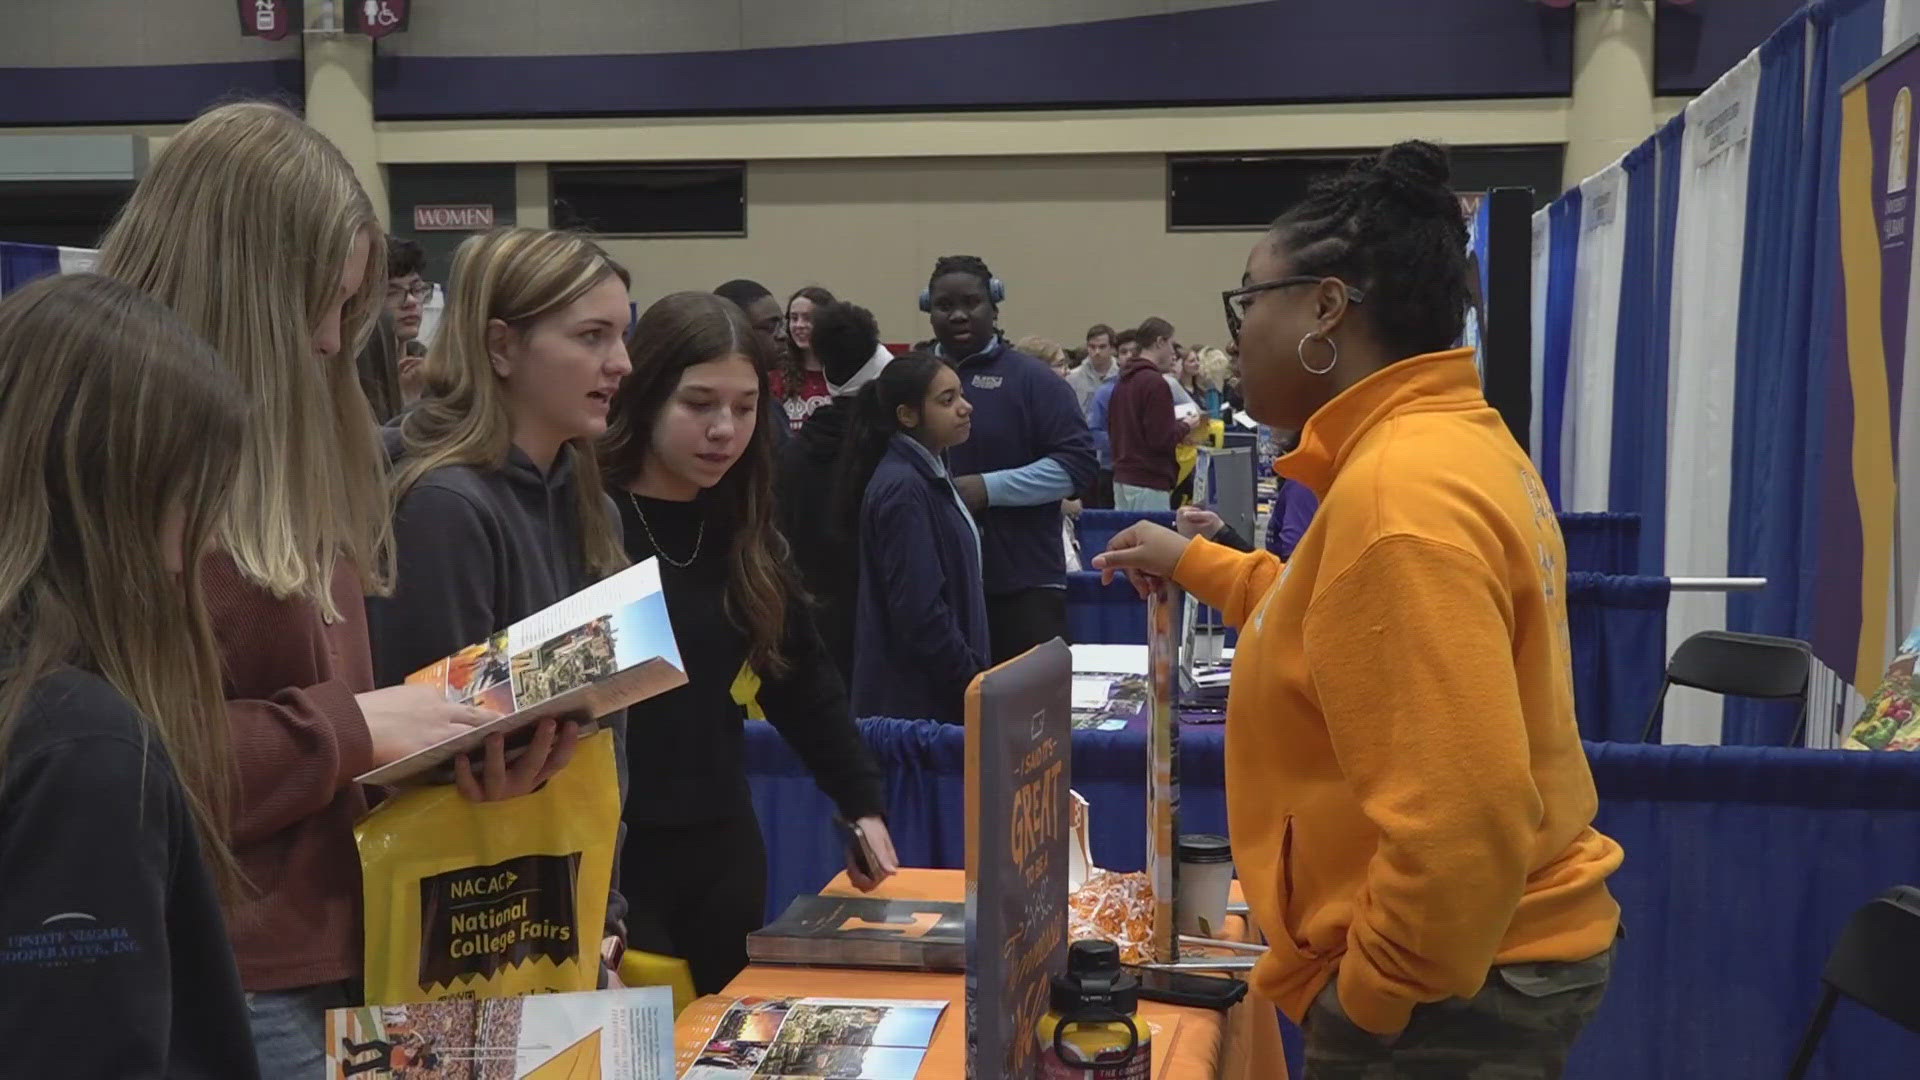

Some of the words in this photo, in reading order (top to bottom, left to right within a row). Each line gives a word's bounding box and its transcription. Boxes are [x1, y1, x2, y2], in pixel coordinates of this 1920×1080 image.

[418, 208, 490, 225] WOMEN
[1011, 760, 1062, 875] GREAT
[451, 872, 506, 899] NACAC
[451, 897, 527, 934] National
[8, 932, 64, 948] UPSTATE
[450, 930, 516, 959] College
[520, 919, 571, 941] Fairs
